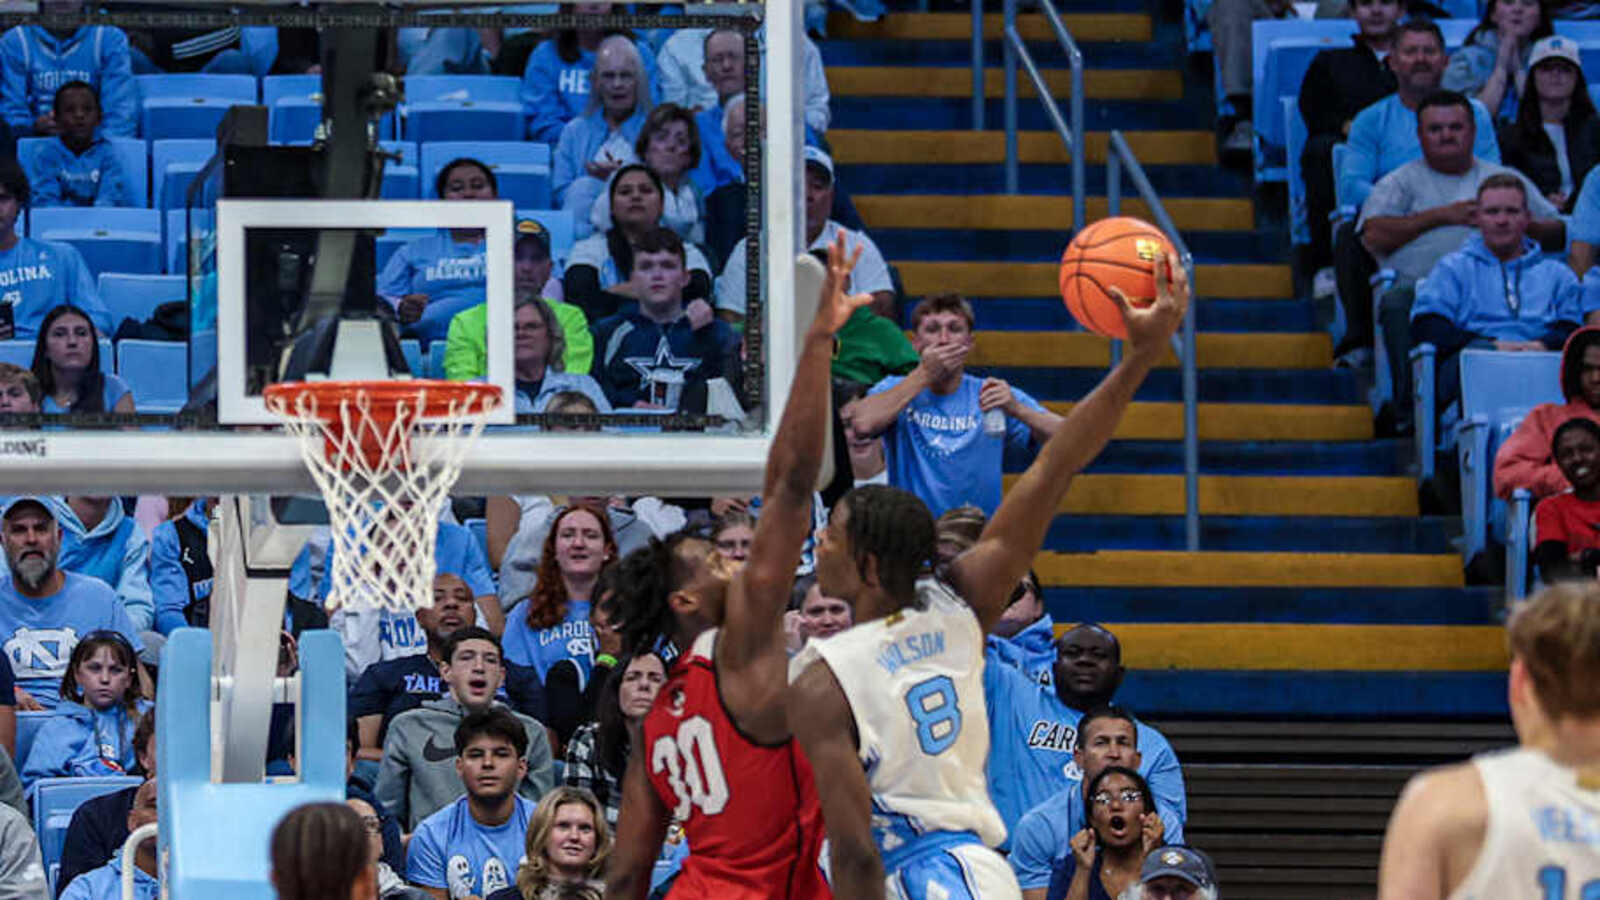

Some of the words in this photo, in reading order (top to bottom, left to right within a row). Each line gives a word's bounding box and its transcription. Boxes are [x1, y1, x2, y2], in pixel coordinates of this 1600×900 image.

[876, 631, 946, 676] WILSON
[904, 674, 962, 757] 8
[651, 714, 730, 822] 30
